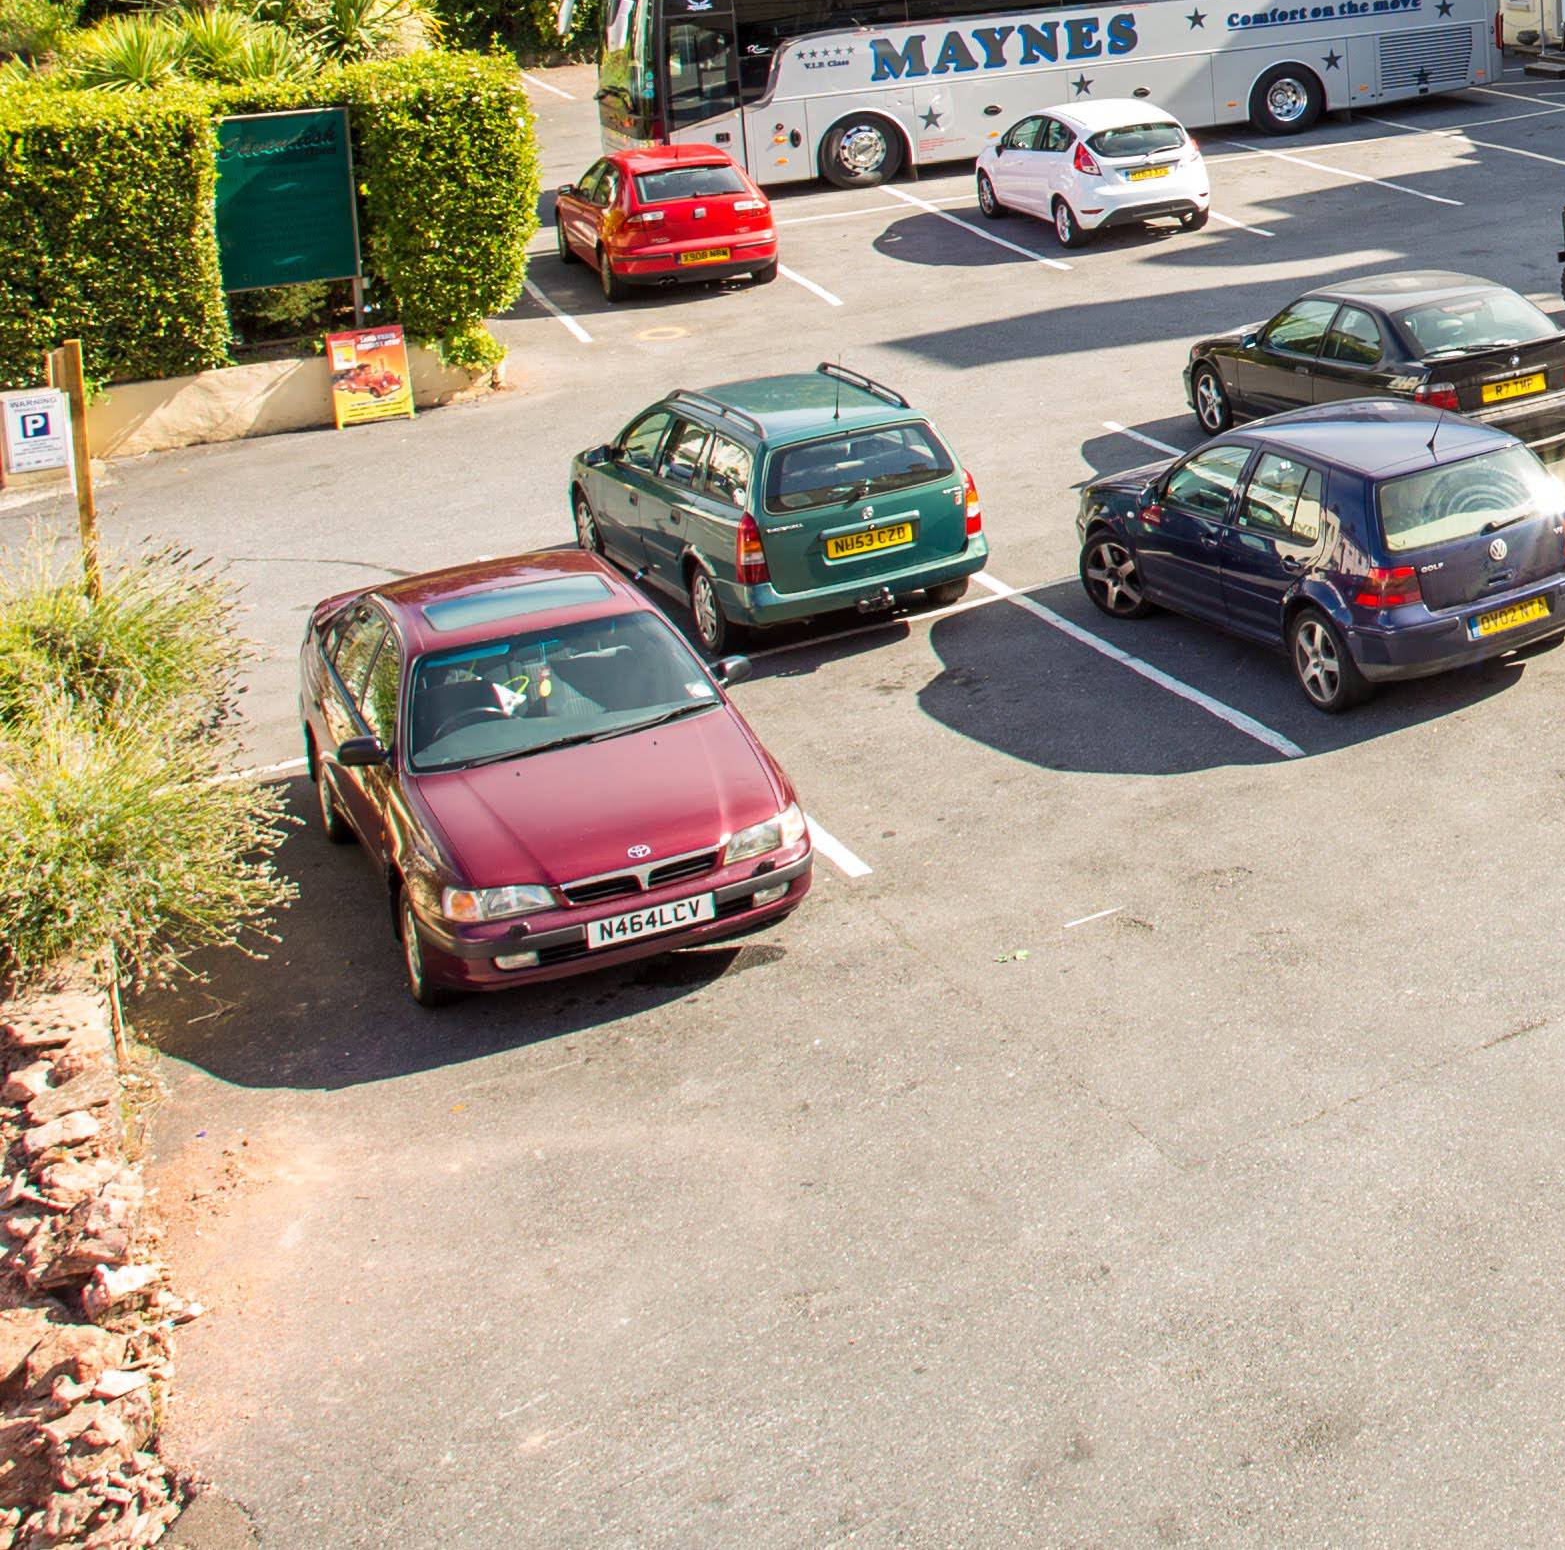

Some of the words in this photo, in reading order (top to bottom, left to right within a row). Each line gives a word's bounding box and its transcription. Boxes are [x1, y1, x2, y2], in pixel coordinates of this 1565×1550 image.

[1226, 7, 1307, 27] Comfort
[1310, 6, 1336, 18] on
[1338, 0, 1369, 15] the
[870, 13, 1139, 82] MAYNES
[25, 414, 46, 437] P
[1420, 562, 1444, 574] GOLF
[600, 899, 700, 941] N464LCV
